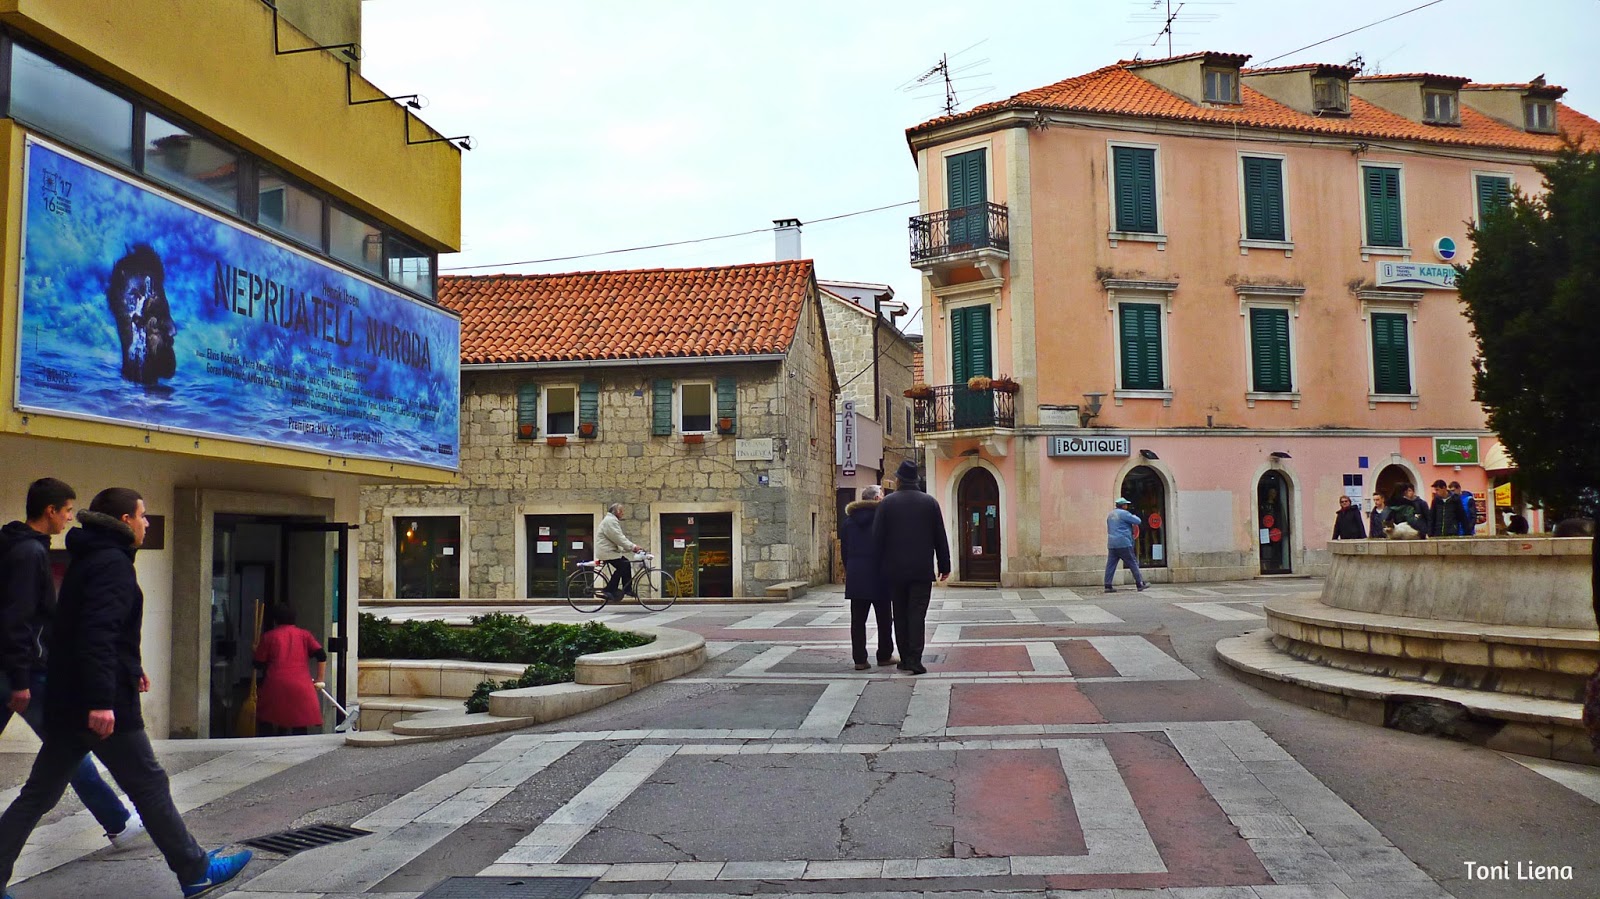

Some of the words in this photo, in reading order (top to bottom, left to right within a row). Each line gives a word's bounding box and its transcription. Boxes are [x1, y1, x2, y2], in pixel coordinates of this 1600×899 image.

[1419, 266, 1457, 278] KATARIN
[214, 259, 353, 347] NEPRIJATELJ
[366, 315, 432, 373] NARODA
[844, 402, 853, 468] GALERIJA
[1063, 440, 1123, 452] BOUTIQUE
